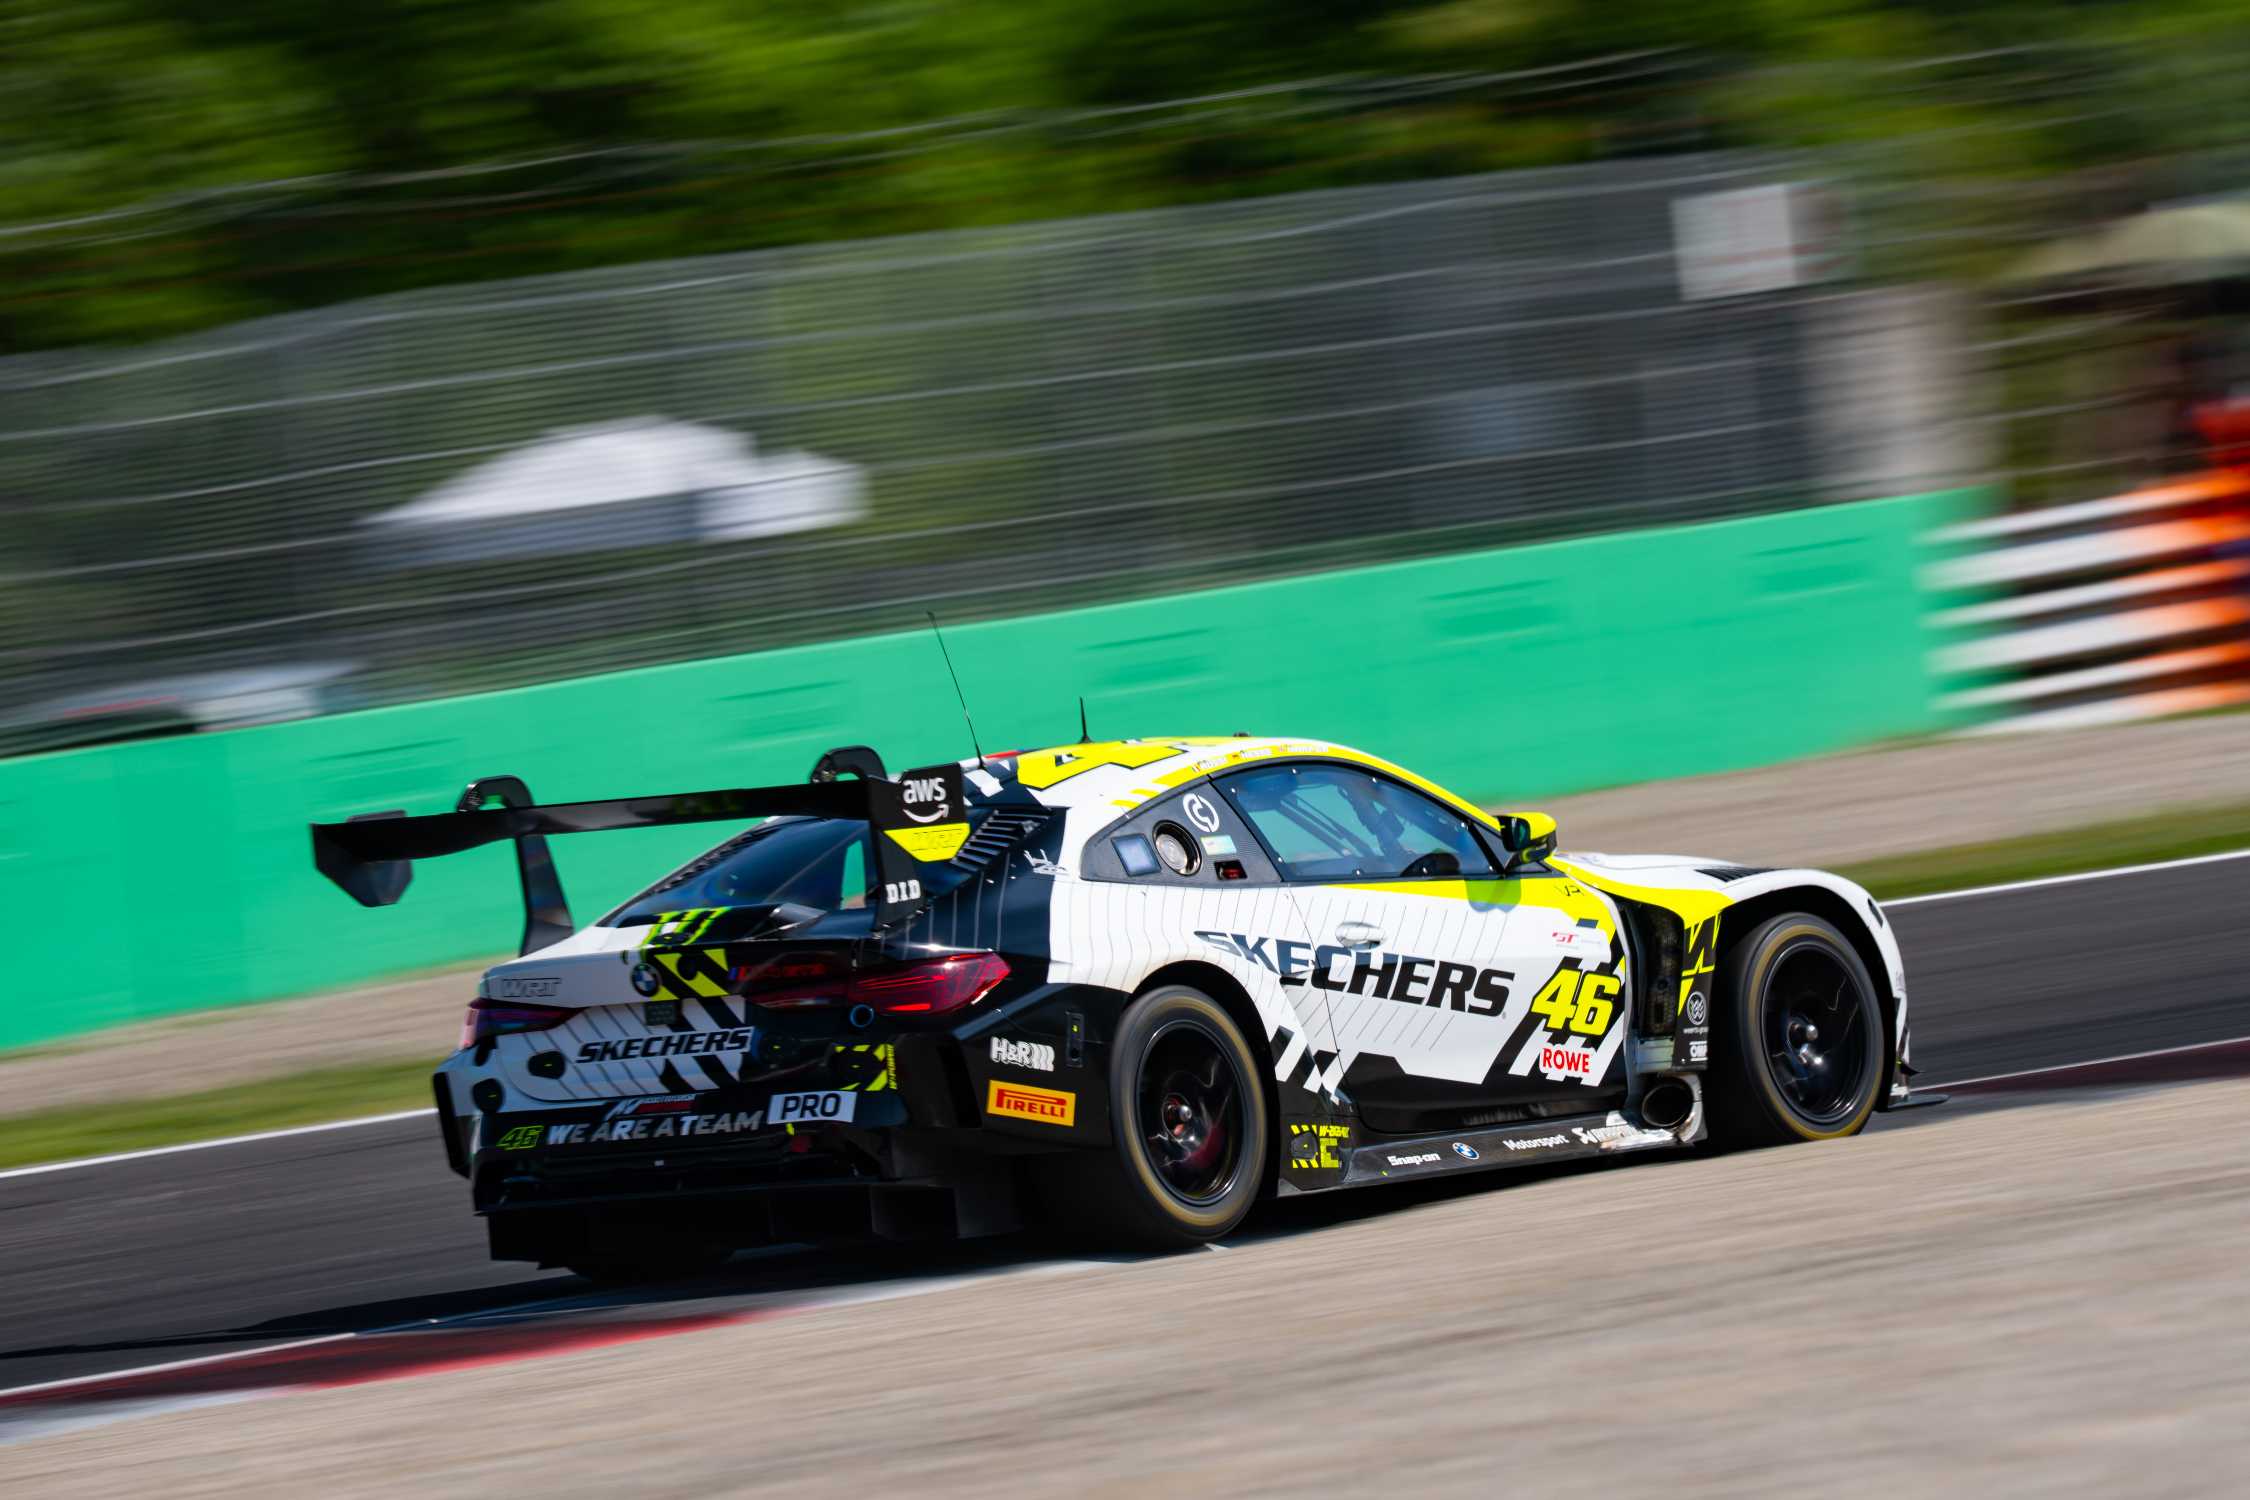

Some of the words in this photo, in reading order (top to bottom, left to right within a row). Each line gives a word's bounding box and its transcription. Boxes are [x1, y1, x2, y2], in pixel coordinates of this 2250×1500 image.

[902, 777, 947, 804] aws
[1193, 930, 1516, 1018] SKECHERS
[1530, 968, 1622, 1036] 46
[575, 1029, 752, 1064] SKECHERS
[990, 1036, 1055, 1072] H&R
[1542, 1047, 1590, 1073] ROWE
[780, 1092, 841, 1121] PRO
[995, 1088, 1067, 1118] PIRELLI
[497, 1124, 544, 1150] 46
[546, 1123, 590, 1145] WE
[589, 1118, 650, 1143] ARE
[652, 1117, 675, 1138] A
[680, 1109, 765, 1136] TEAM
[1502, 1133, 1570, 1151] Motorsport
[1386, 1152, 1441, 1167] Snap-on
